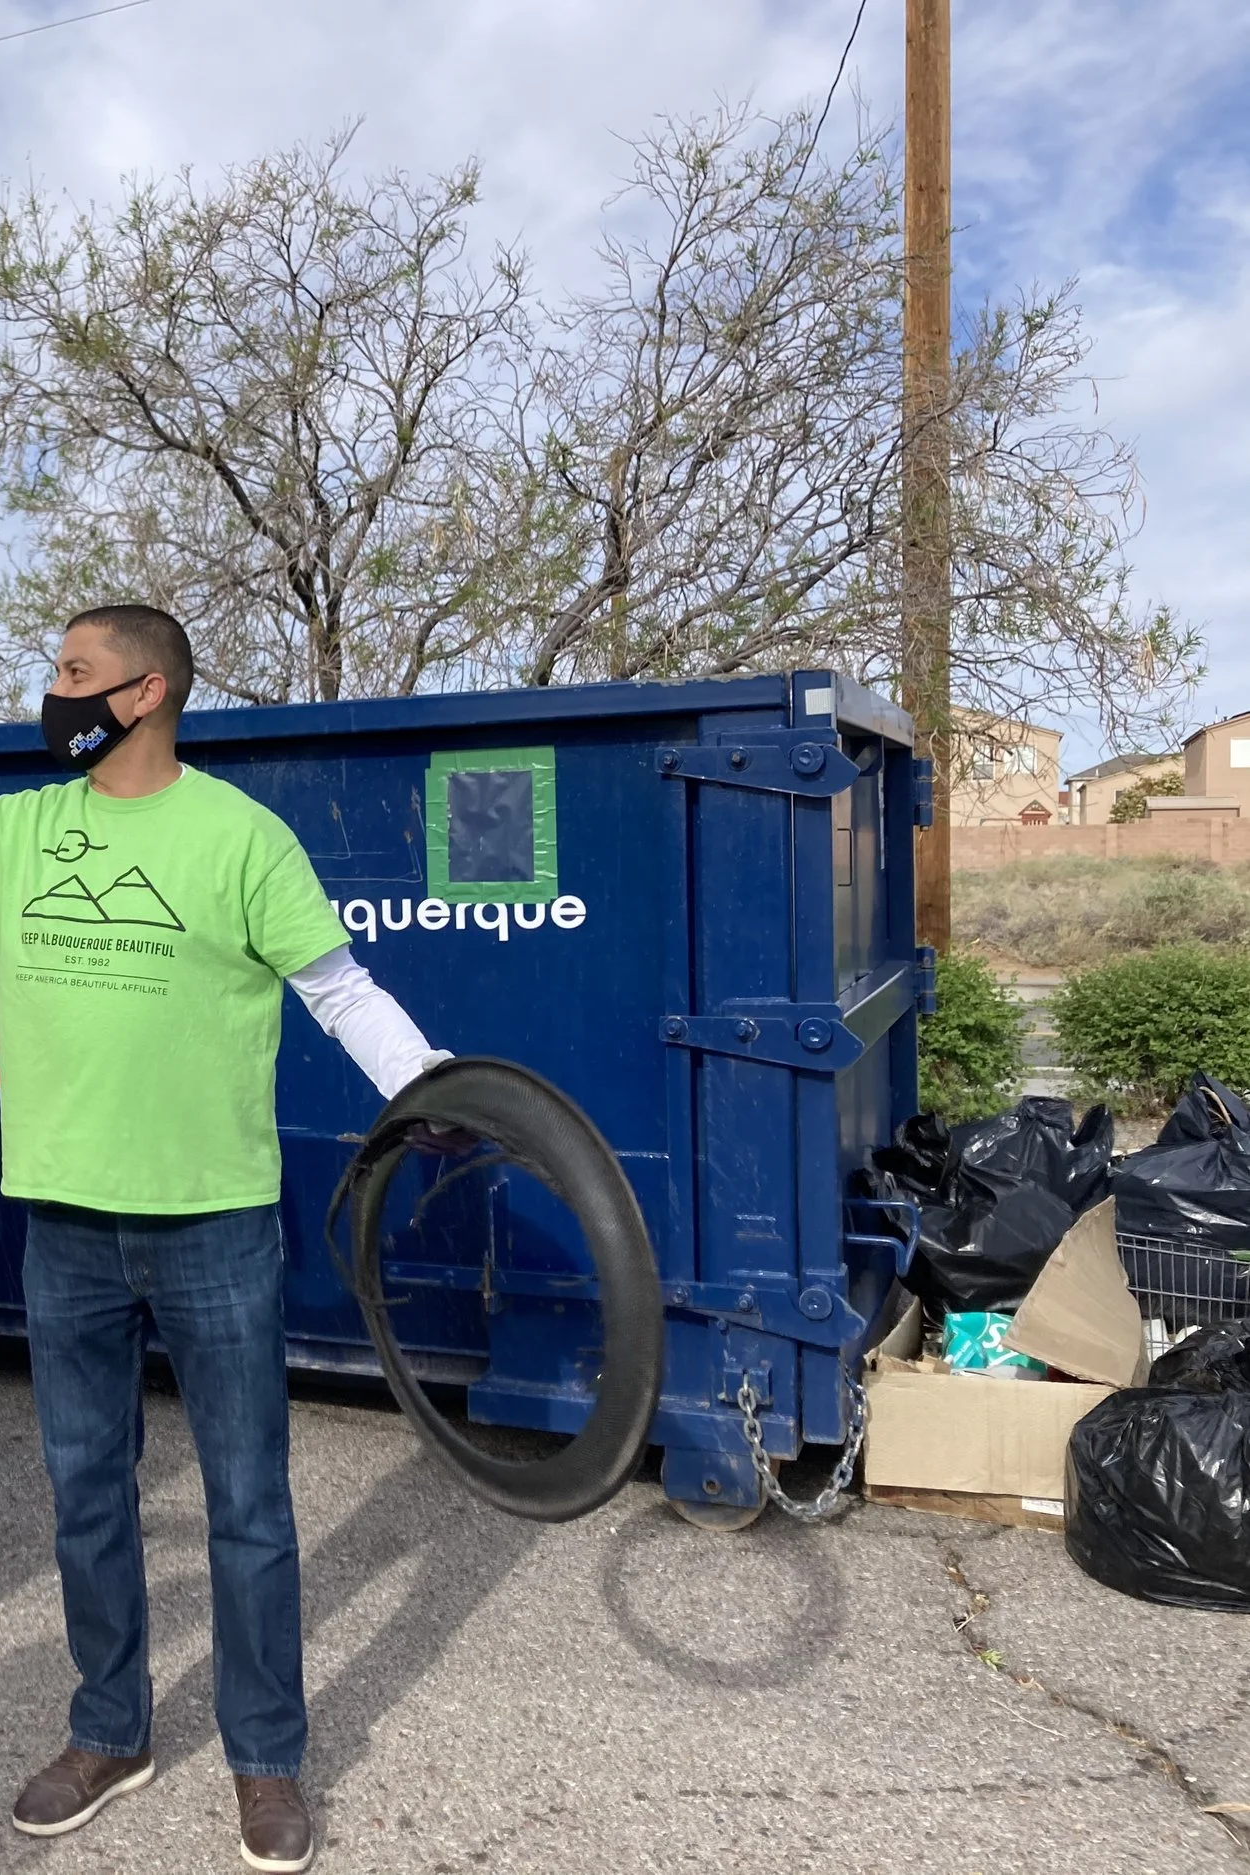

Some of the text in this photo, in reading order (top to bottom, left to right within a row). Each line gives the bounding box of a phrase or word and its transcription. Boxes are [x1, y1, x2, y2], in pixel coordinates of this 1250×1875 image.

[40, 932, 114, 951] ALBUQUERQUE
[115, 938, 176, 958] BEAUTIFUL
[64, 954, 111, 967] EST. 1982
[15, 972, 169, 996] KEEP AMERICA BEAUTIFUL AFFILIATE
